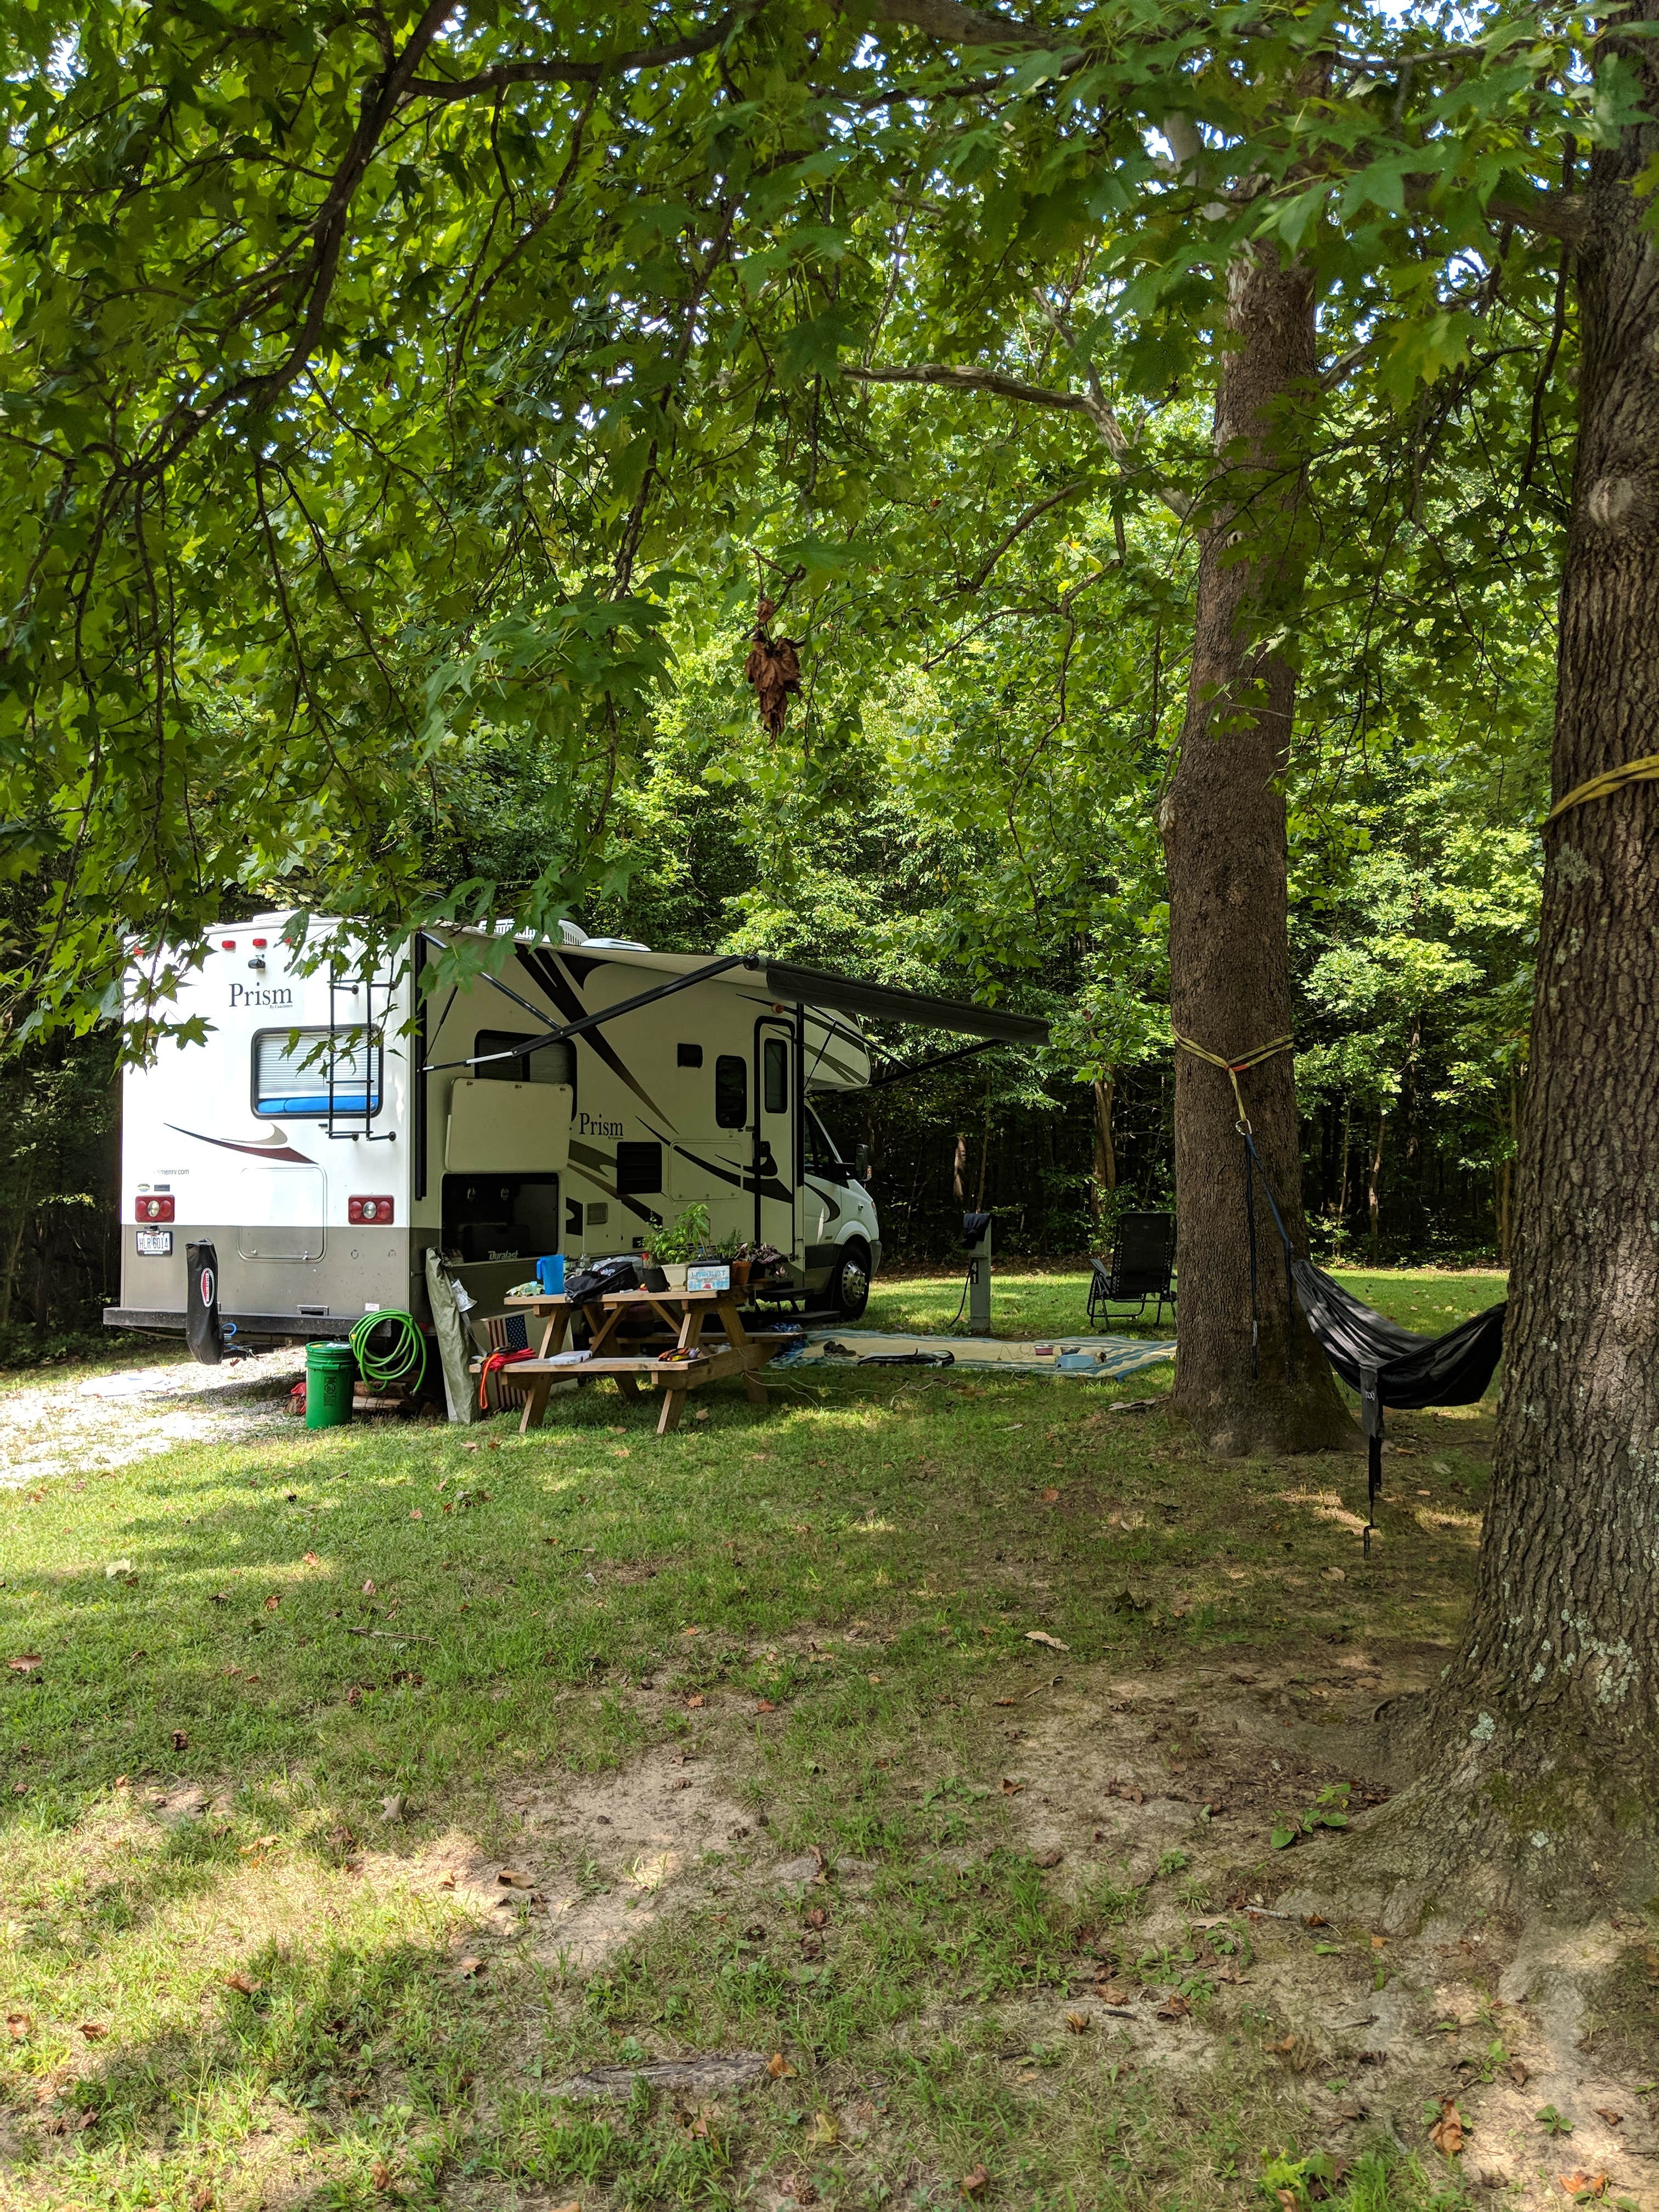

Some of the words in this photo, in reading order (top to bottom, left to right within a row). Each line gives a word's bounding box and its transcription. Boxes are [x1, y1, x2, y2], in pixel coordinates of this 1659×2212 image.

[229, 982, 292, 1007] Prism
[579, 1113, 623, 1136] Prism
[139, 1238, 151, 1249] HLR
[488, 1250, 518, 1260] Duralast
